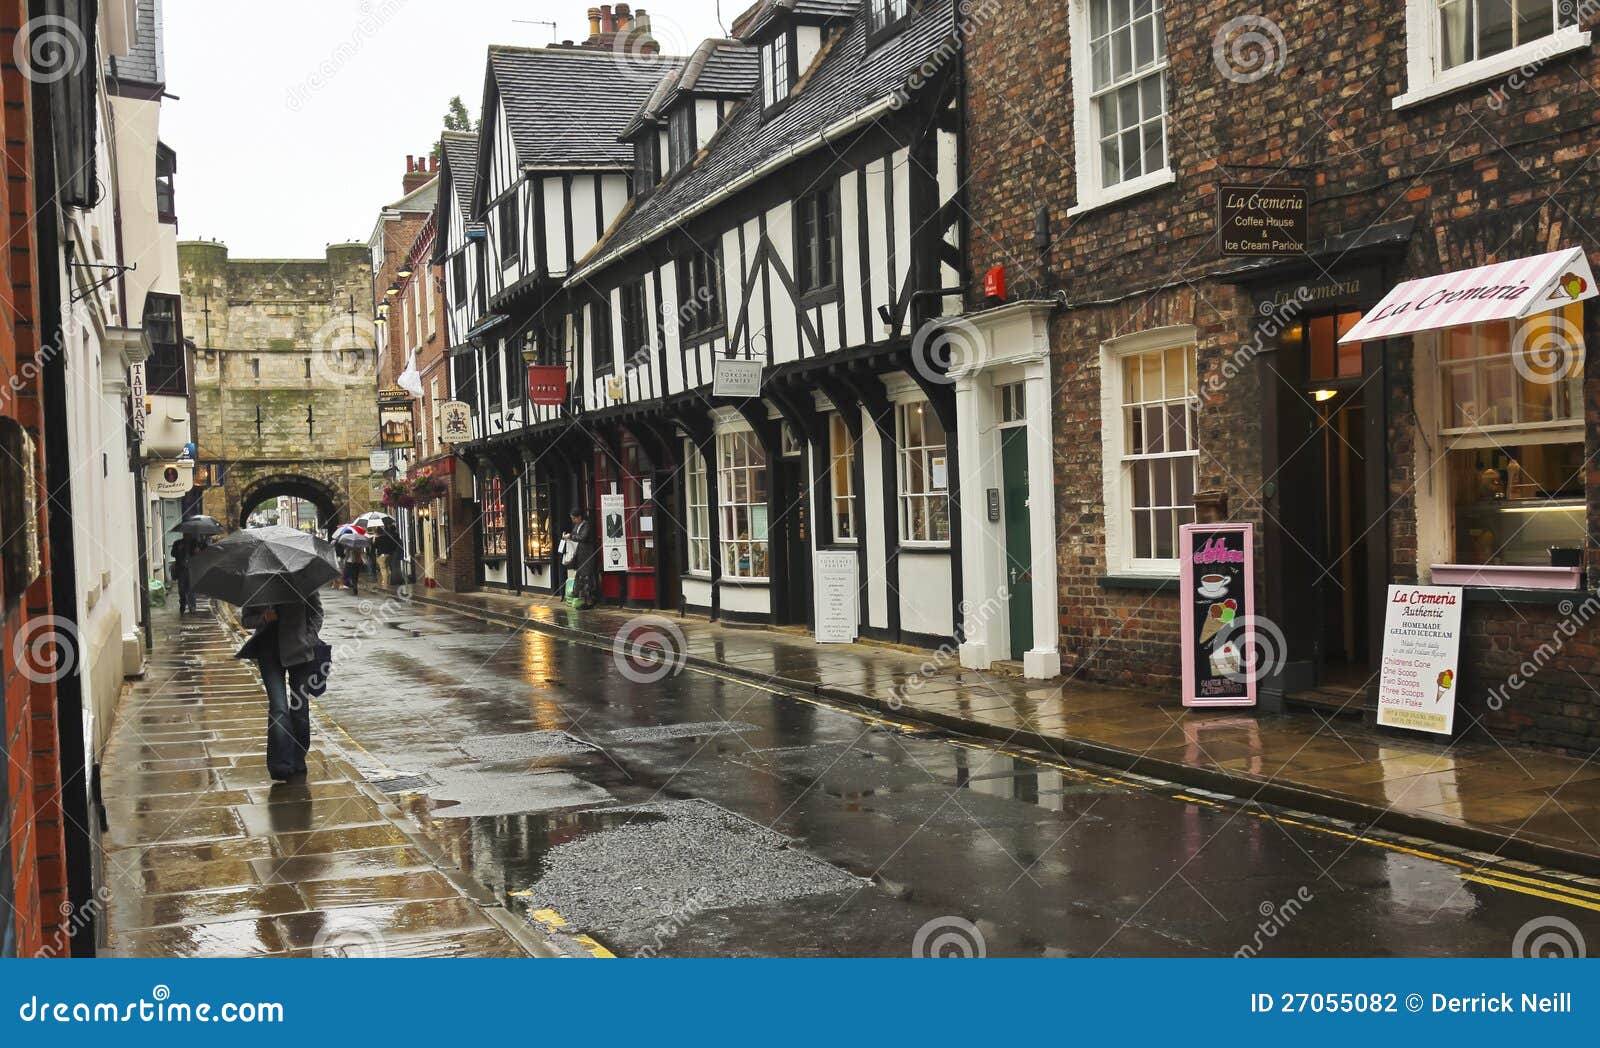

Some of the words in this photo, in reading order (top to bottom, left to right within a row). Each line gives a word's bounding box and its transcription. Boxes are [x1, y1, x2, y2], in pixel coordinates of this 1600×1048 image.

[1226, 193, 1244, 208] La
[1248, 193, 1303, 210] Cremeria
[1235, 216, 1264, 226] Coffee
[1266, 217, 1294, 226] House
[1262, 230, 1268, 238] &
[1225, 240, 1238, 250] Ice
[1241, 240, 1270, 250] Cream
[1272, 240, 1304, 250] Parlour
[1367, 301, 1408, 324] La
[1414, 279, 1530, 311] Cremeria
[1392, 590, 1408, 603] La
[1410, 590, 1456, 605] Cremeria
[1402, 606, 1444, 618] Authentic
[1402, 622, 1440, 630] HOMEMADE
[1418, 630, 1452, 639] ICECREAM
[1384, 656, 1412, 666] Childrens
[1414, 660, 1431, 668] Cone
[1384, 666, 1396, 674] One
[1398, 668, 1418, 678] Scoop
[1383, 676, 1395, 684] Two
[1398, 678, 1420, 688] Scoops
[1382, 686, 1400, 695] Three
[1402, 688, 1424, 698] Scoops
[1381, 696, 1400, 705] Sauce
[1405, 698, 1422, 707] Flake
